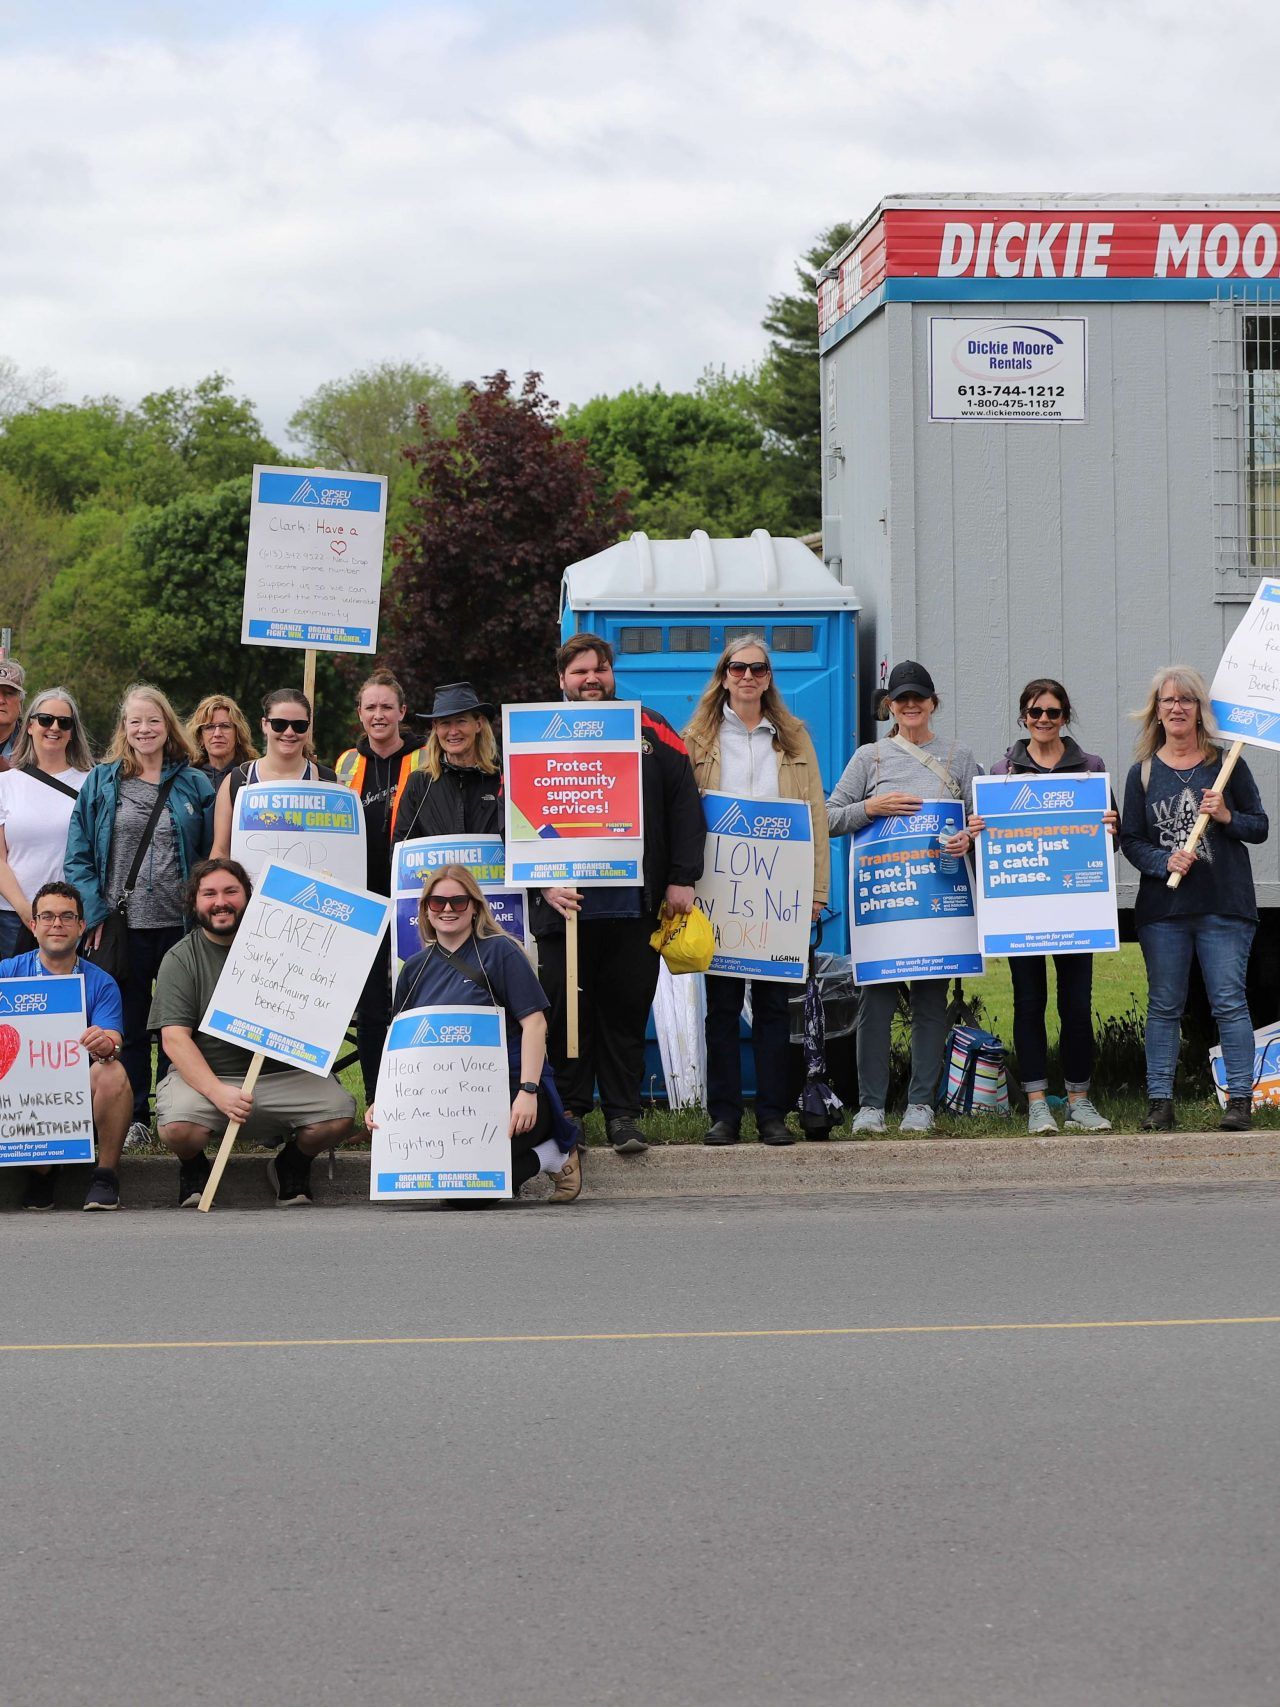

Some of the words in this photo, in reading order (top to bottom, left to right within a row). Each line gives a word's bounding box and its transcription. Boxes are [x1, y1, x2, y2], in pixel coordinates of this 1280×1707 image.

[938, 222, 1114, 277] DICKIE
[968, 341, 1008, 355] Dickie
[1013, 341, 1054, 355] Moore
[990, 357, 1032, 369] Rentals
[957, 385, 1065, 397] 613-744-1212
[967, 400, 1056, 408] 1-800-475-1187
[316, 520, 344, 535] Have
[1225, 655, 1239, 671] to
[573, 721, 604, 730] OPSEU
[572, 729, 603, 738] SEFPO
[547, 759, 602, 772] Protect
[534, 775, 616, 789] community
[250, 796, 268, 809] ON
[272, 795, 326, 809] STRIKE!
[547, 788, 603, 803] support
[1043, 791, 1074, 800] OPSEU
[542, 801, 609, 814] services!
[1042, 799, 1074, 809] SEFPO
[754, 816, 792, 828] OPSEU
[752, 827, 790, 839] SEFPO
[987, 824, 1100, 839] Transparency
[988, 842, 1002, 854] is
[1006, 841, 1034, 853] not
[1036, 838, 1069, 854] just
[406, 852, 425, 867] ON
[428, 848, 482, 865] STRIKE!
[715, 836, 780, 881] LOW
[989, 859, 999, 869] a
[1003, 855, 1049, 868] catch
[553, 870, 569, 878] WIN.
[859, 870, 870, 883] is
[875, 866, 902, 879] not
[905, 862, 936, 878] just
[990, 871, 1051, 888] phrase.
[860, 885, 868, 897] a
[872, 879, 917, 894] catch
[765, 888, 802, 924] Not
[860, 896, 920, 915] phrase.
[310, 967, 337, 989] don't
[14, 994, 48, 1004] OPSEU
[14, 1002, 47, 1012] SEFPO
[440, 1025, 472, 1035] OPSEU
[438, 1034, 471, 1043] SEFPO
[29, 1039, 82, 1070] HUB
[387, 1057, 423, 1079] Hear
[395, 1083, 425, 1098] Hear
[19, 1091, 84, 1107] WORKERS
[383, 1109, 407, 1122] We
[411, 1108, 431, 1120] Are
[0, 1120, 91, 1138] COMMITMENT
[387, 1132, 445, 1161] Fighting
